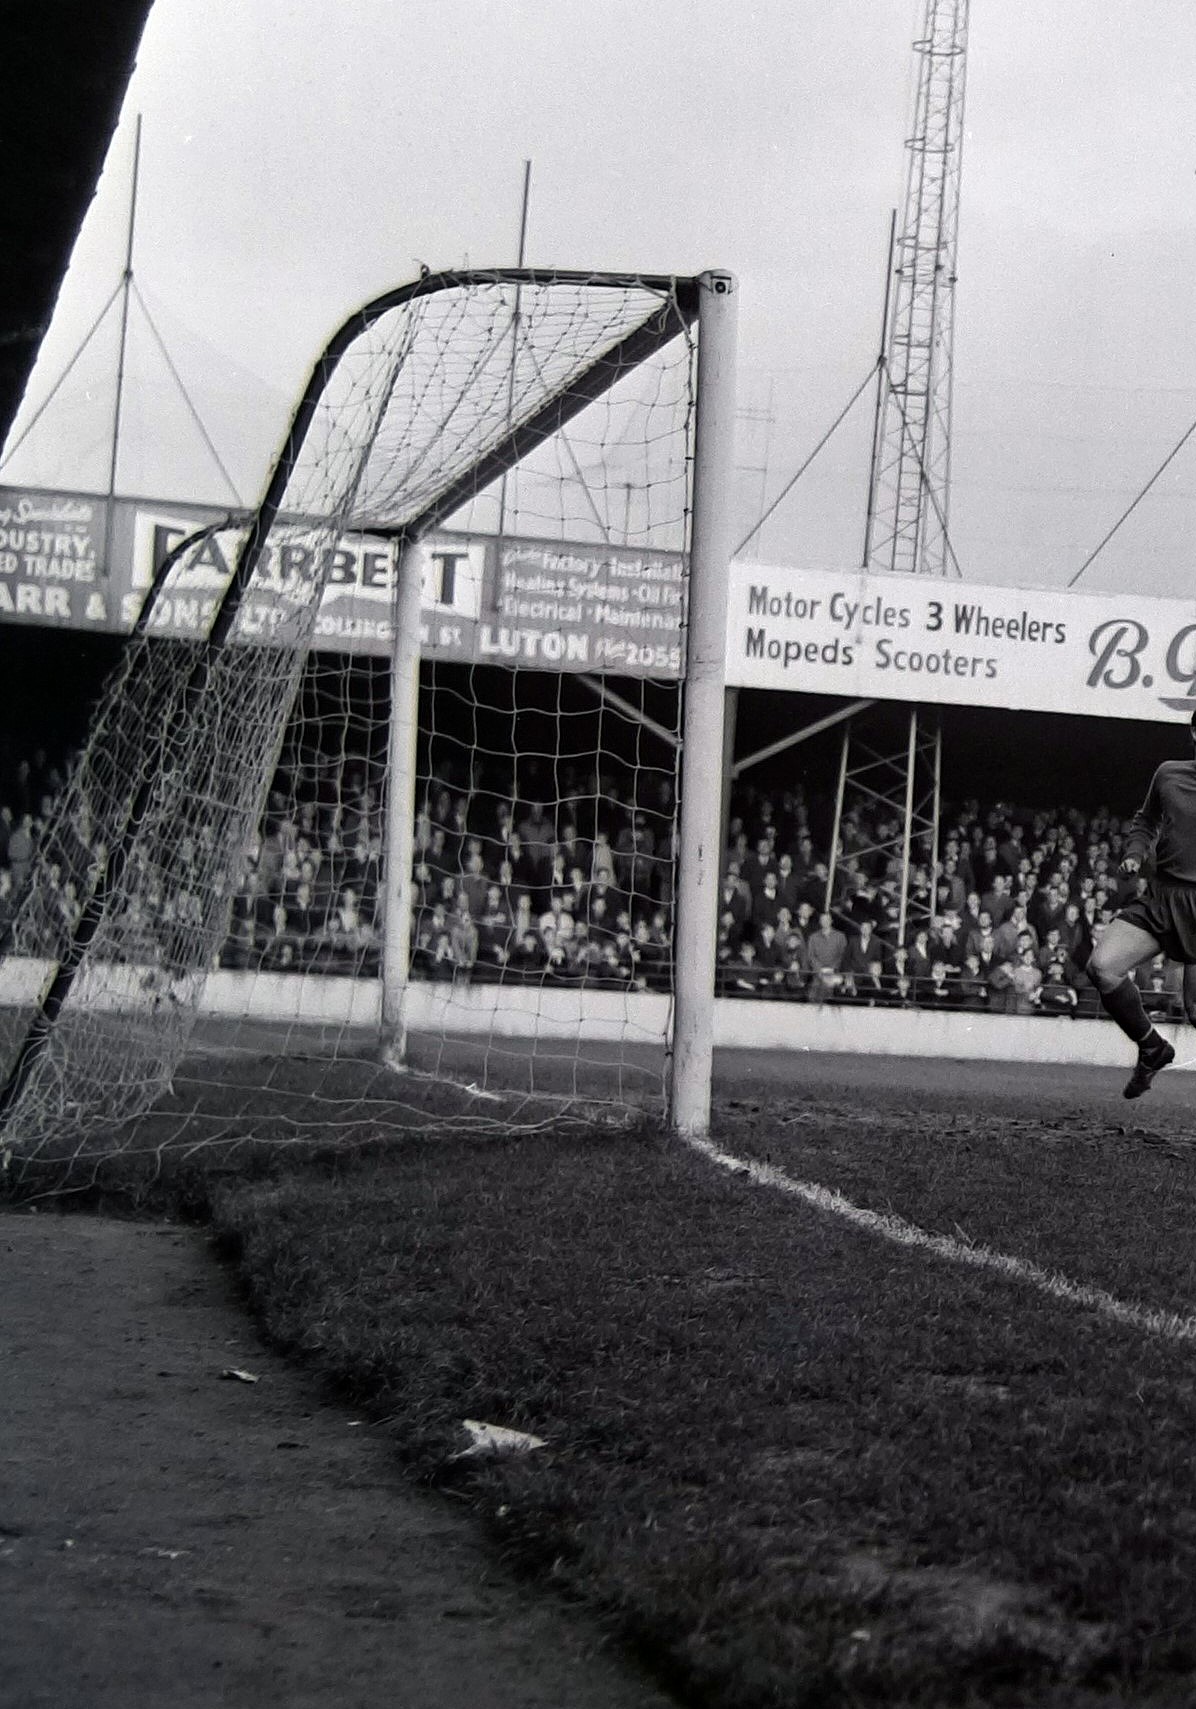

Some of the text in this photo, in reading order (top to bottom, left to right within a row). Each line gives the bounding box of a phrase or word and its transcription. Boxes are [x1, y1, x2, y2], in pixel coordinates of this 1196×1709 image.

[749, 585, 1067, 645] Motor Cycles 3 Wheelers
[480, 626, 591, 664] LUTON
[745, 627, 999, 679] Mopeds Scooters
